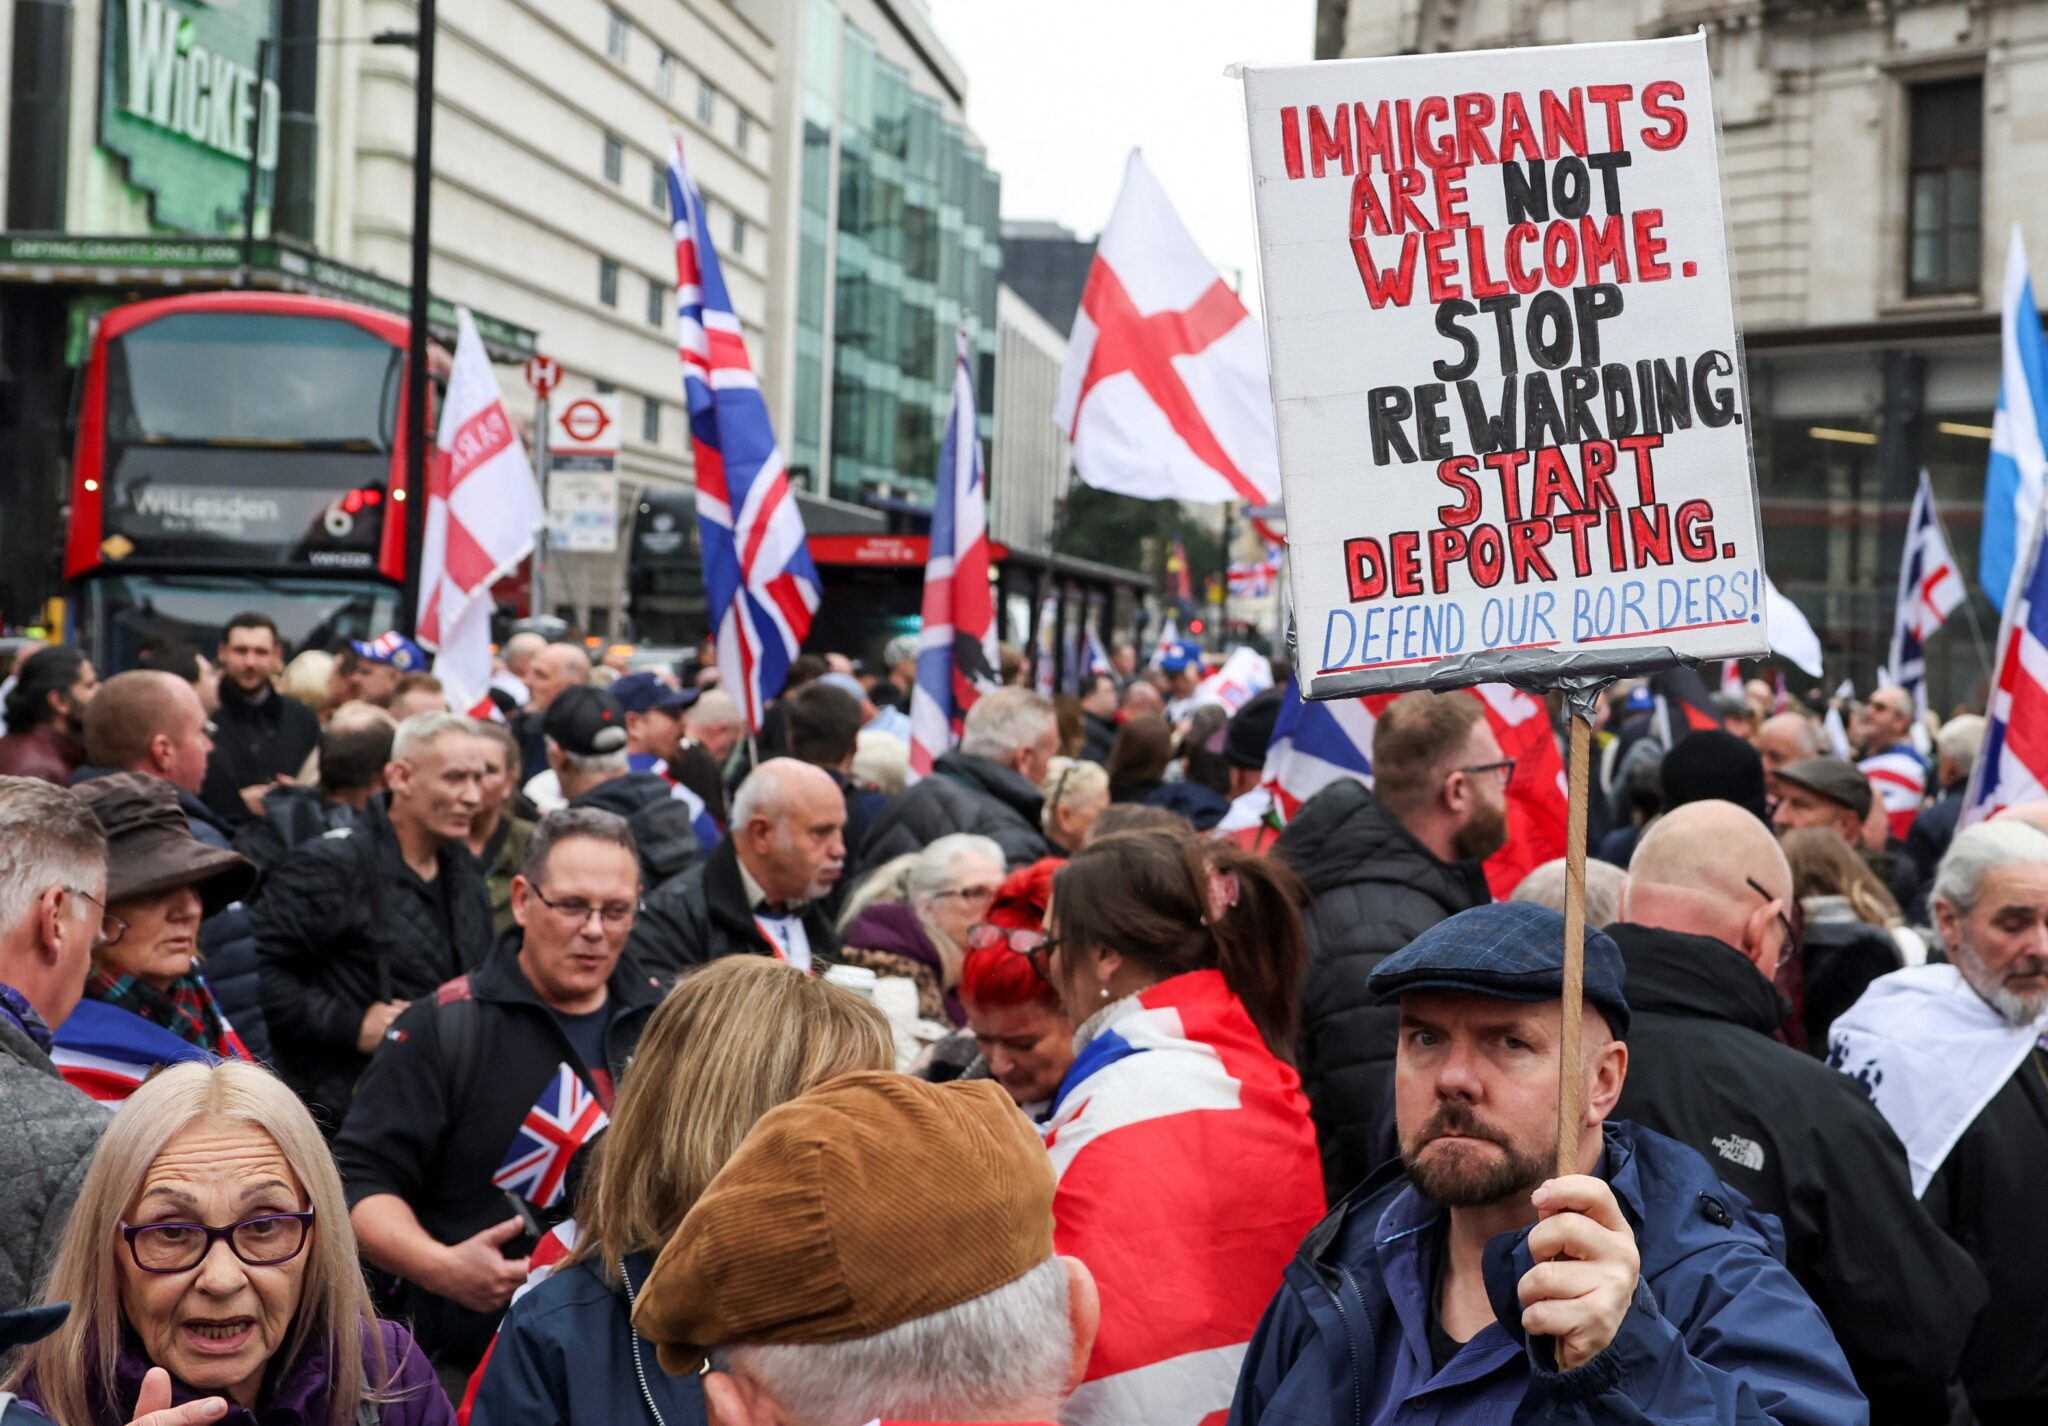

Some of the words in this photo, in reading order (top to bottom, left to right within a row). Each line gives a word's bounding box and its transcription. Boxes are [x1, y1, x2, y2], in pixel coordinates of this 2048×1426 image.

[1280, 80, 1688, 180] IMMIGRANTS
[1349, 165, 1470, 238] ARE
[1503, 151, 1632, 224] NOT
[1350, 208, 1698, 309] WELCOME.
[530, 359, 556, 389] H
[1433, 283, 1624, 382] STOP
[1367, 349, 1743, 466] REWARDING.
[132, 488, 279, 520] Willesden
[324, 497, 353, 537] 6
[1437, 433, 1664, 528] START
[1344, 499, 1736, 603] DEPORTING.
[1322, 602, 1465, 671] DEFEND
[1482, 591, 1557, 648] OUR
[1573, 568, 1761, 643] BORDERS!
